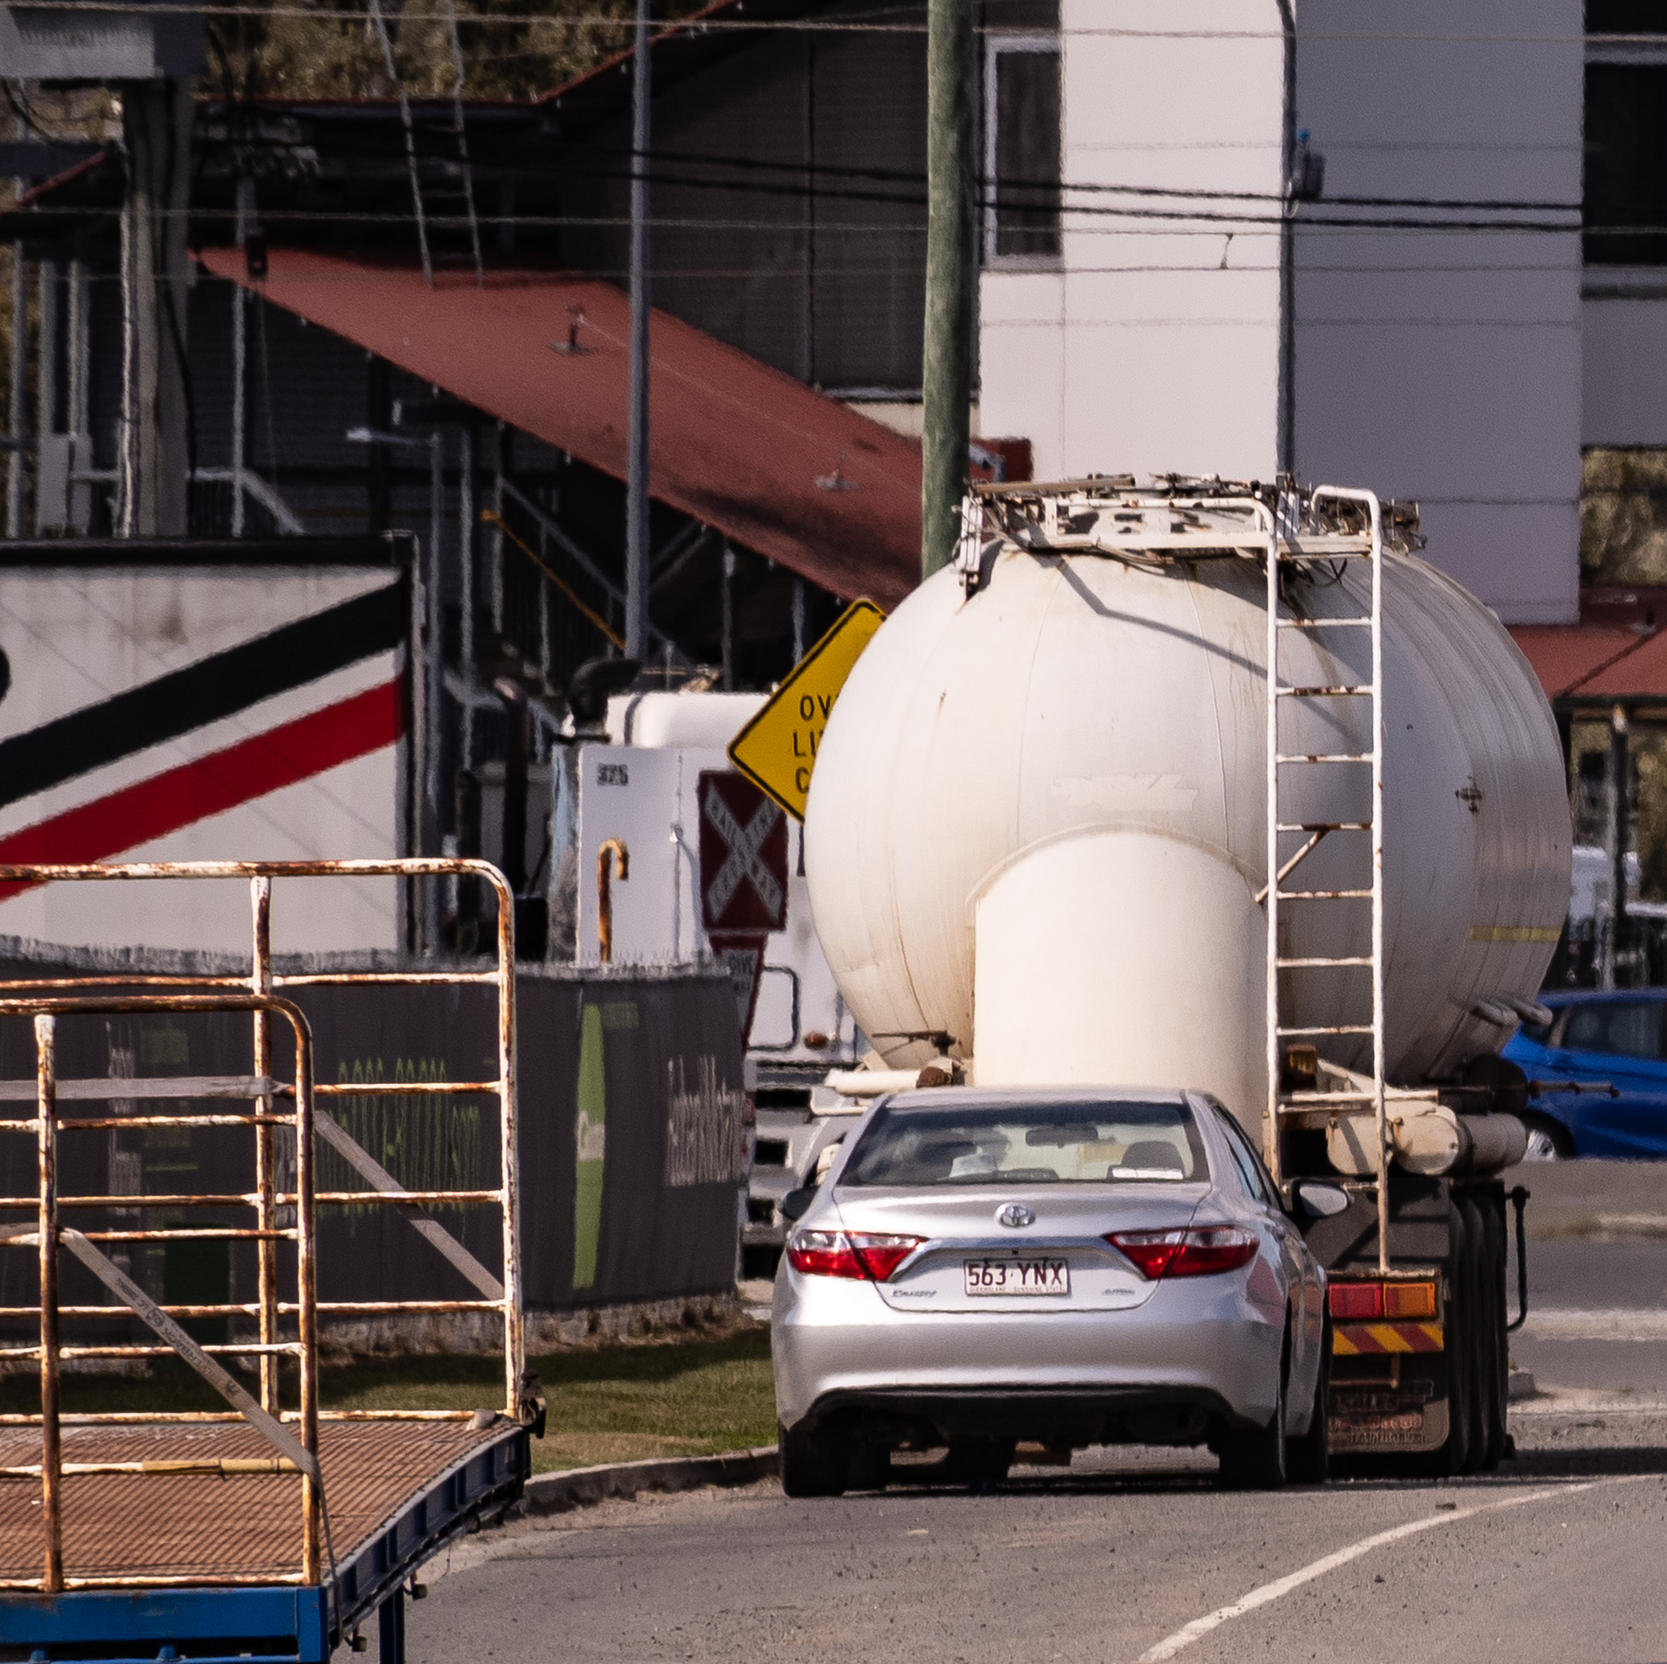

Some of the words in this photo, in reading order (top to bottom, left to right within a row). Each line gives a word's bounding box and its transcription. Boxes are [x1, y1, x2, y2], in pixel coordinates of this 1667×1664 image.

[800, 695, 840, 721] OV
[968, 1263, 1006, 1286] 563
[1017, 1262, 1063, 1285] YNX
